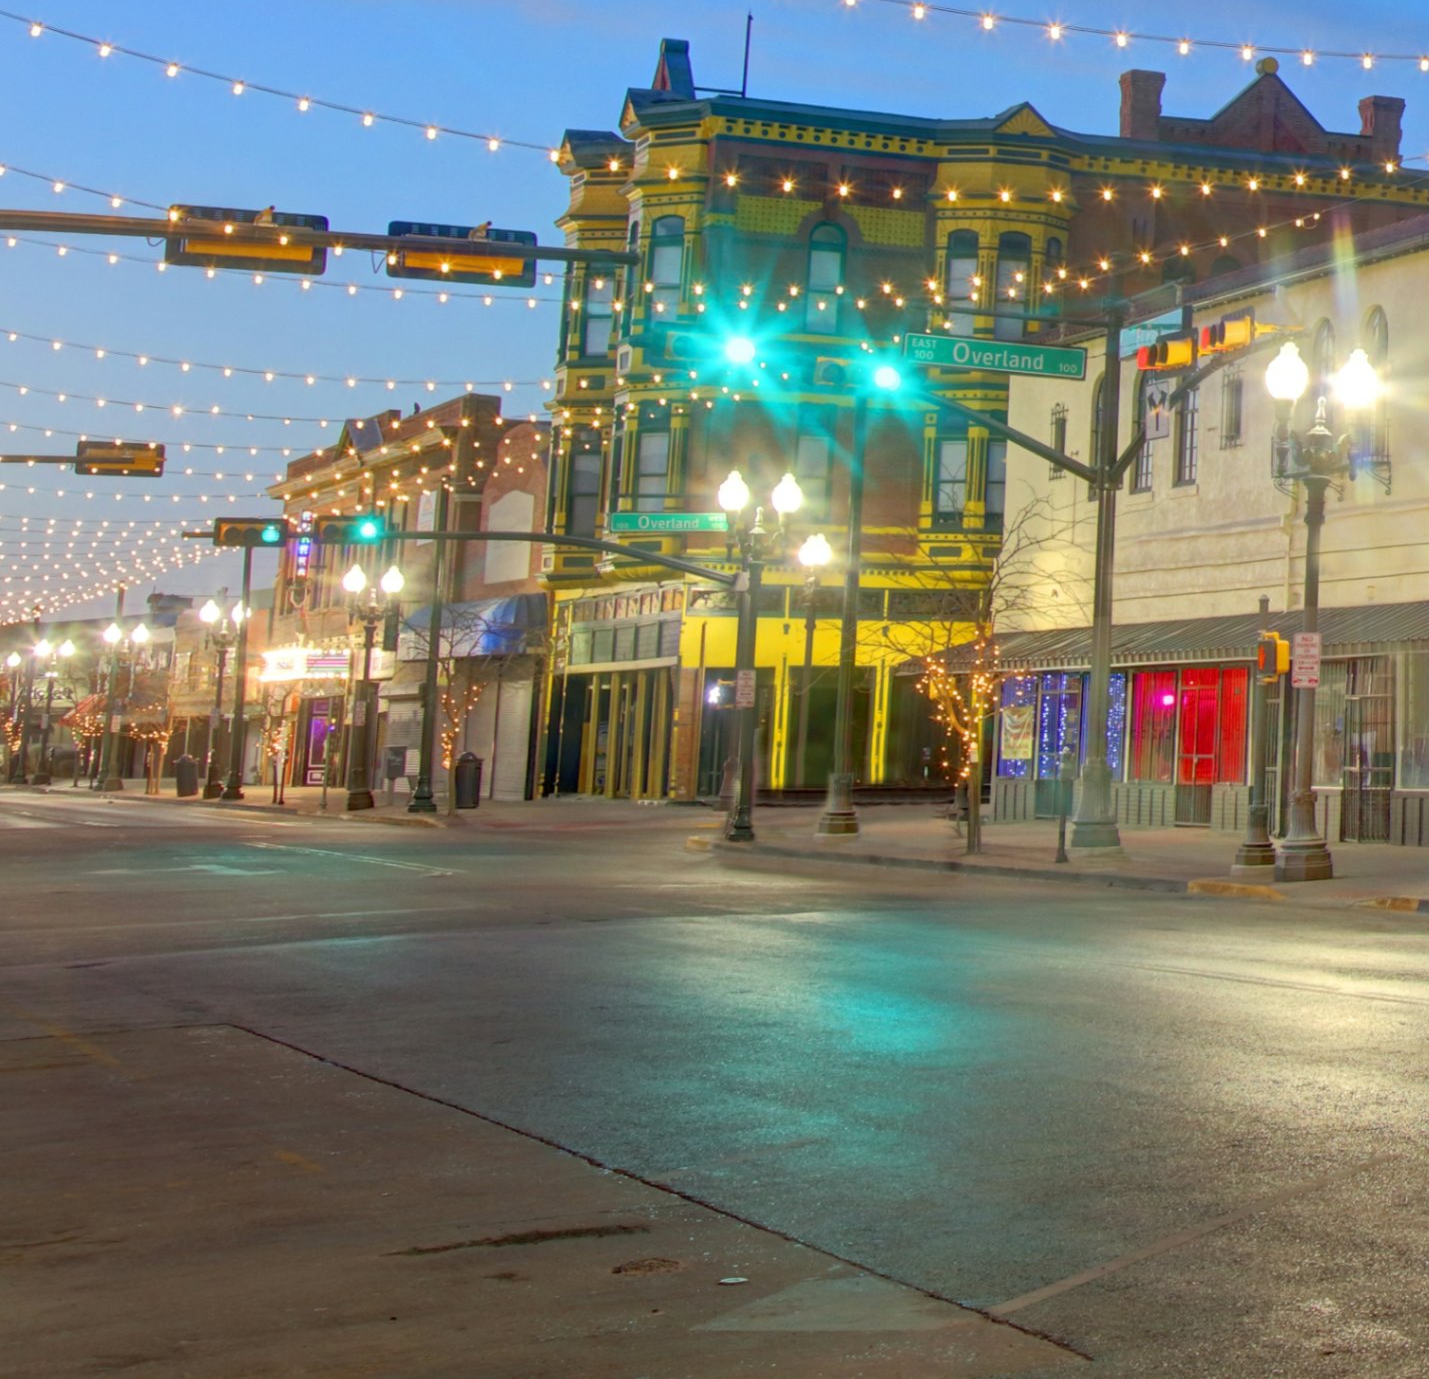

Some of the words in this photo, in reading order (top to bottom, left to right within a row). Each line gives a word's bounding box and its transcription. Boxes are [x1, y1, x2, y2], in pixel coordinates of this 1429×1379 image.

[911, 338, 938, 349] EAST
[914, 350, 934, 360] 100
[952, 342, 1044, 370] Overland
[1058, 363, 1078, 373] 100
[638, 515, 699, 529] Overland
